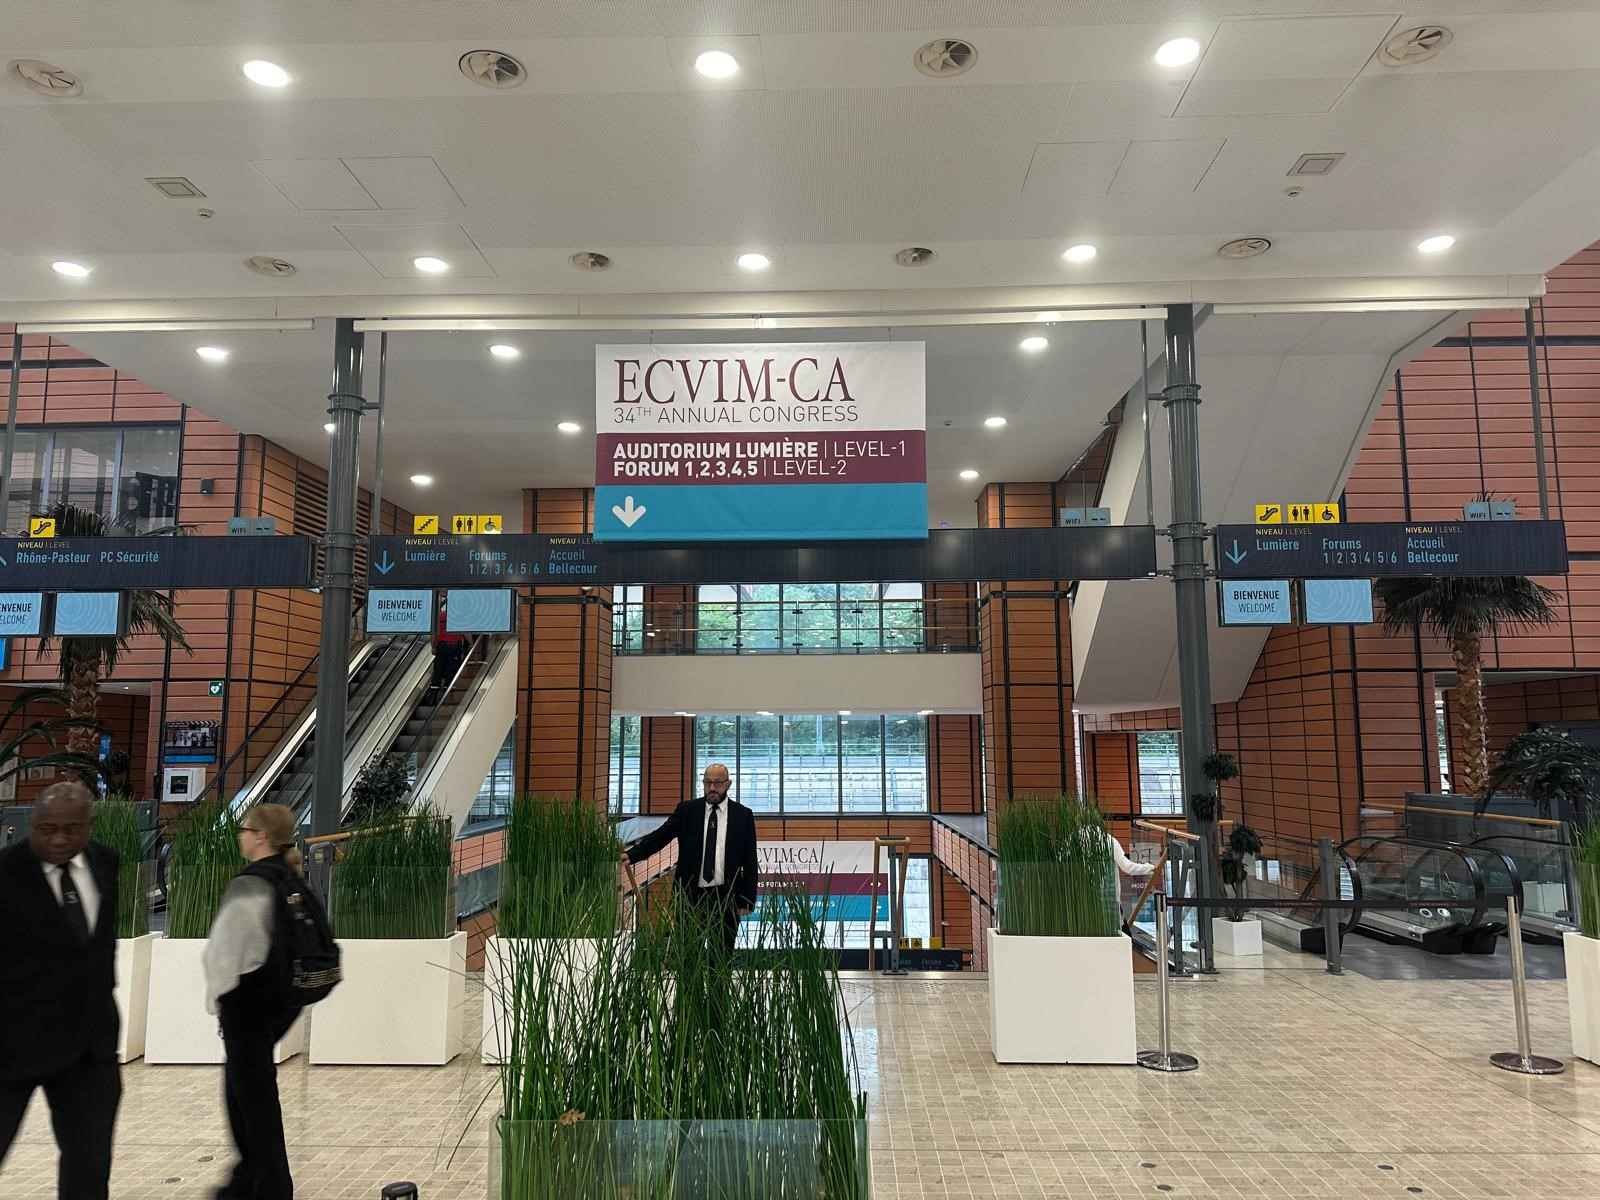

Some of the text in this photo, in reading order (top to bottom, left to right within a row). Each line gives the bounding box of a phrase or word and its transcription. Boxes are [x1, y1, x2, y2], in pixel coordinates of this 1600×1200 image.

[613, 356, 855, 404] ECVIM-CA
[657, 407, 743, 424] ANNUAL
[749, 405, 858, 424] CONGRESS
[613, 436, 906, 459] AUDITORIUM LUMIÈRE LEVEL-1
[613, 459, 847, 479] FORUM 1,2,3,4,5 LEVEL-2
[17, 541, 44, 549] NIVEAU
[548, 537, 577, 545] NIVEAU
[1256, 538, 1300, 551] Lumière
[1322, 538, 1362, 550] Forums
[1407, 536, 1446, 549] Accueil
[16, 551, 160, 563] Rhône-Pasteur PC Sécurité
[405, 548, 447, 561] Lumière
[469, 550, 507, 561] Forums
[549, 548, 585, 560] Accueil
[1407, 551, 1460, 563] Bellecour
[548, 562, 599, 574] Bellecour
[1233, 590, 1280, 600] BIENVENUE
[377, 599, 423, 609] BIENVENUE
[1238, 602, 1276, 613] WELCOME
[381, 611, 417, 622] WELCOME
